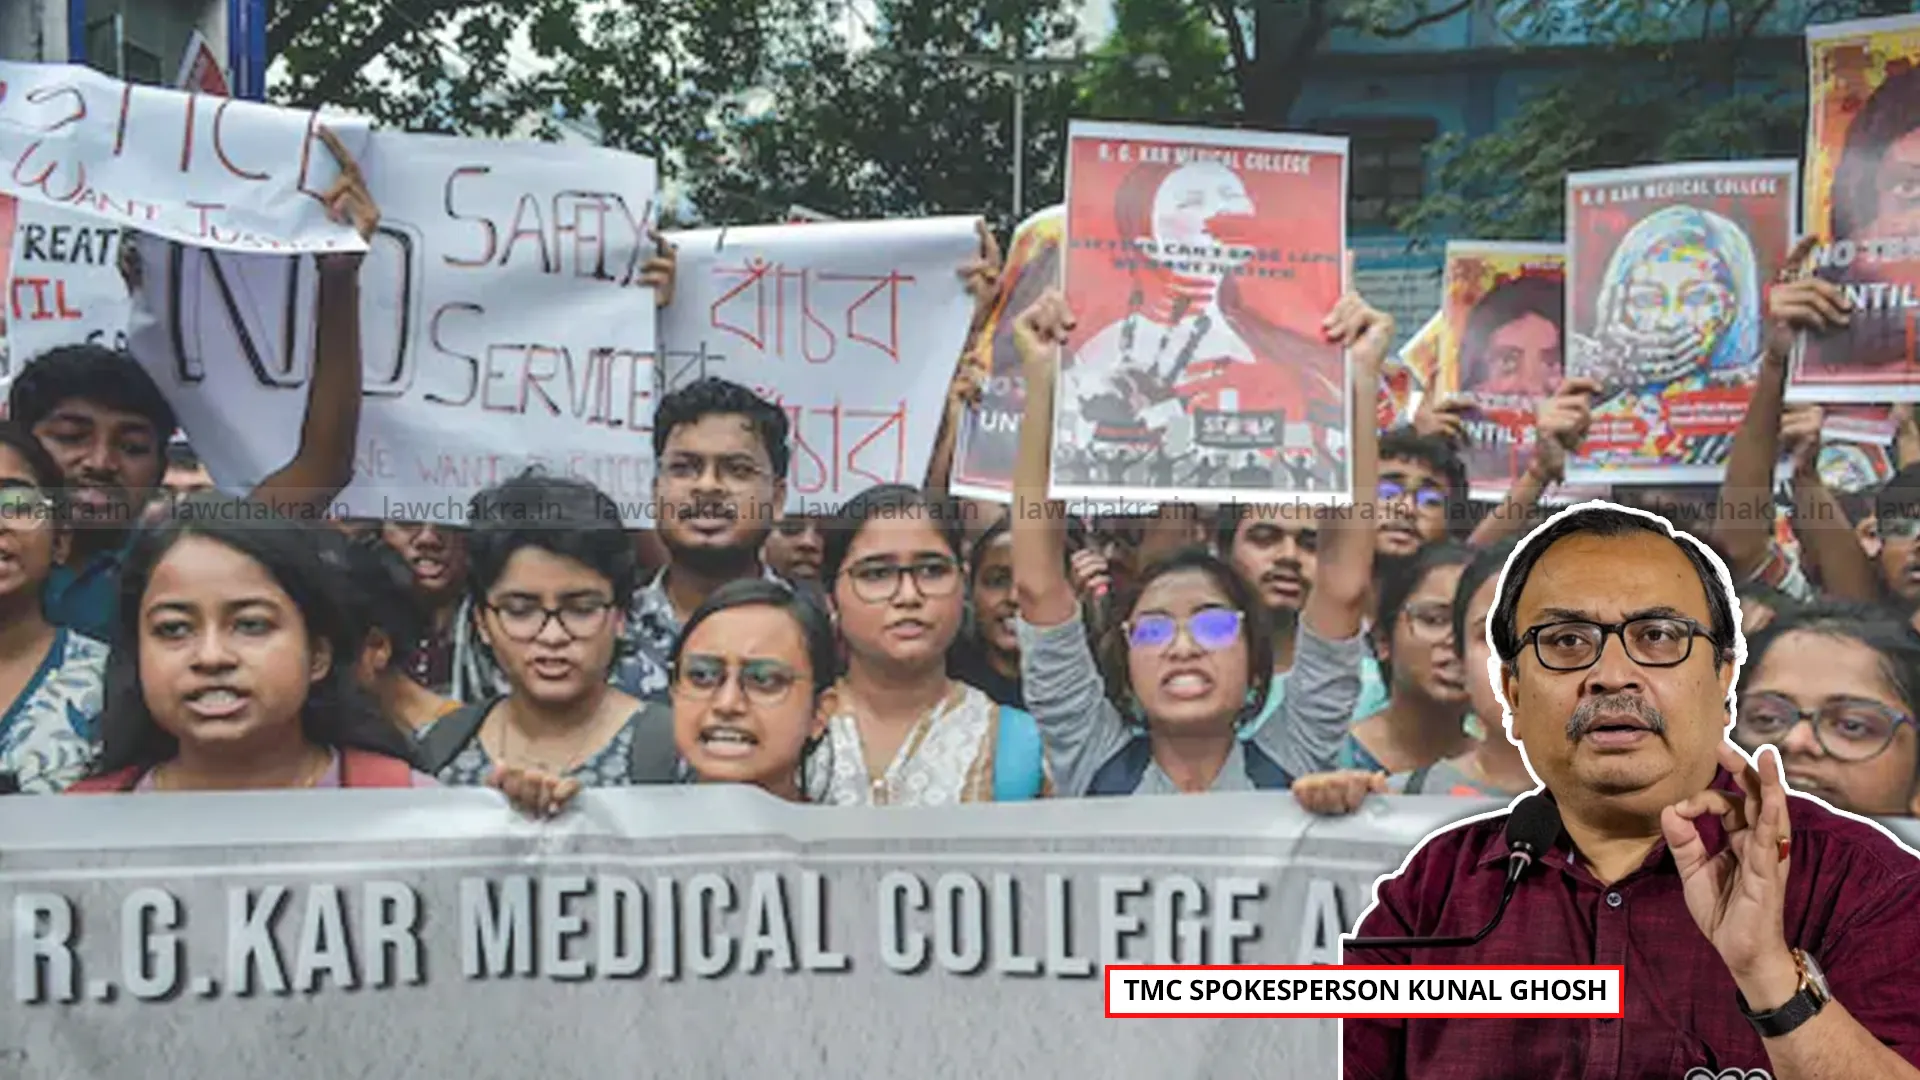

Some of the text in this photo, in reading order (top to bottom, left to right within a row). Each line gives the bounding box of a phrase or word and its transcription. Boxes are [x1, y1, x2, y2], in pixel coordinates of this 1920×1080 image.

[20, 224, 120, 266] REAT
[1843, 282, 1920, 311] NTIL
[423, 301, 655, 432] SERVICE
[980, 410, 1026, 433] UN
[461, 870, 851, 982] MEDICAL
[876, 868, 1270, 982] COLLEGE
